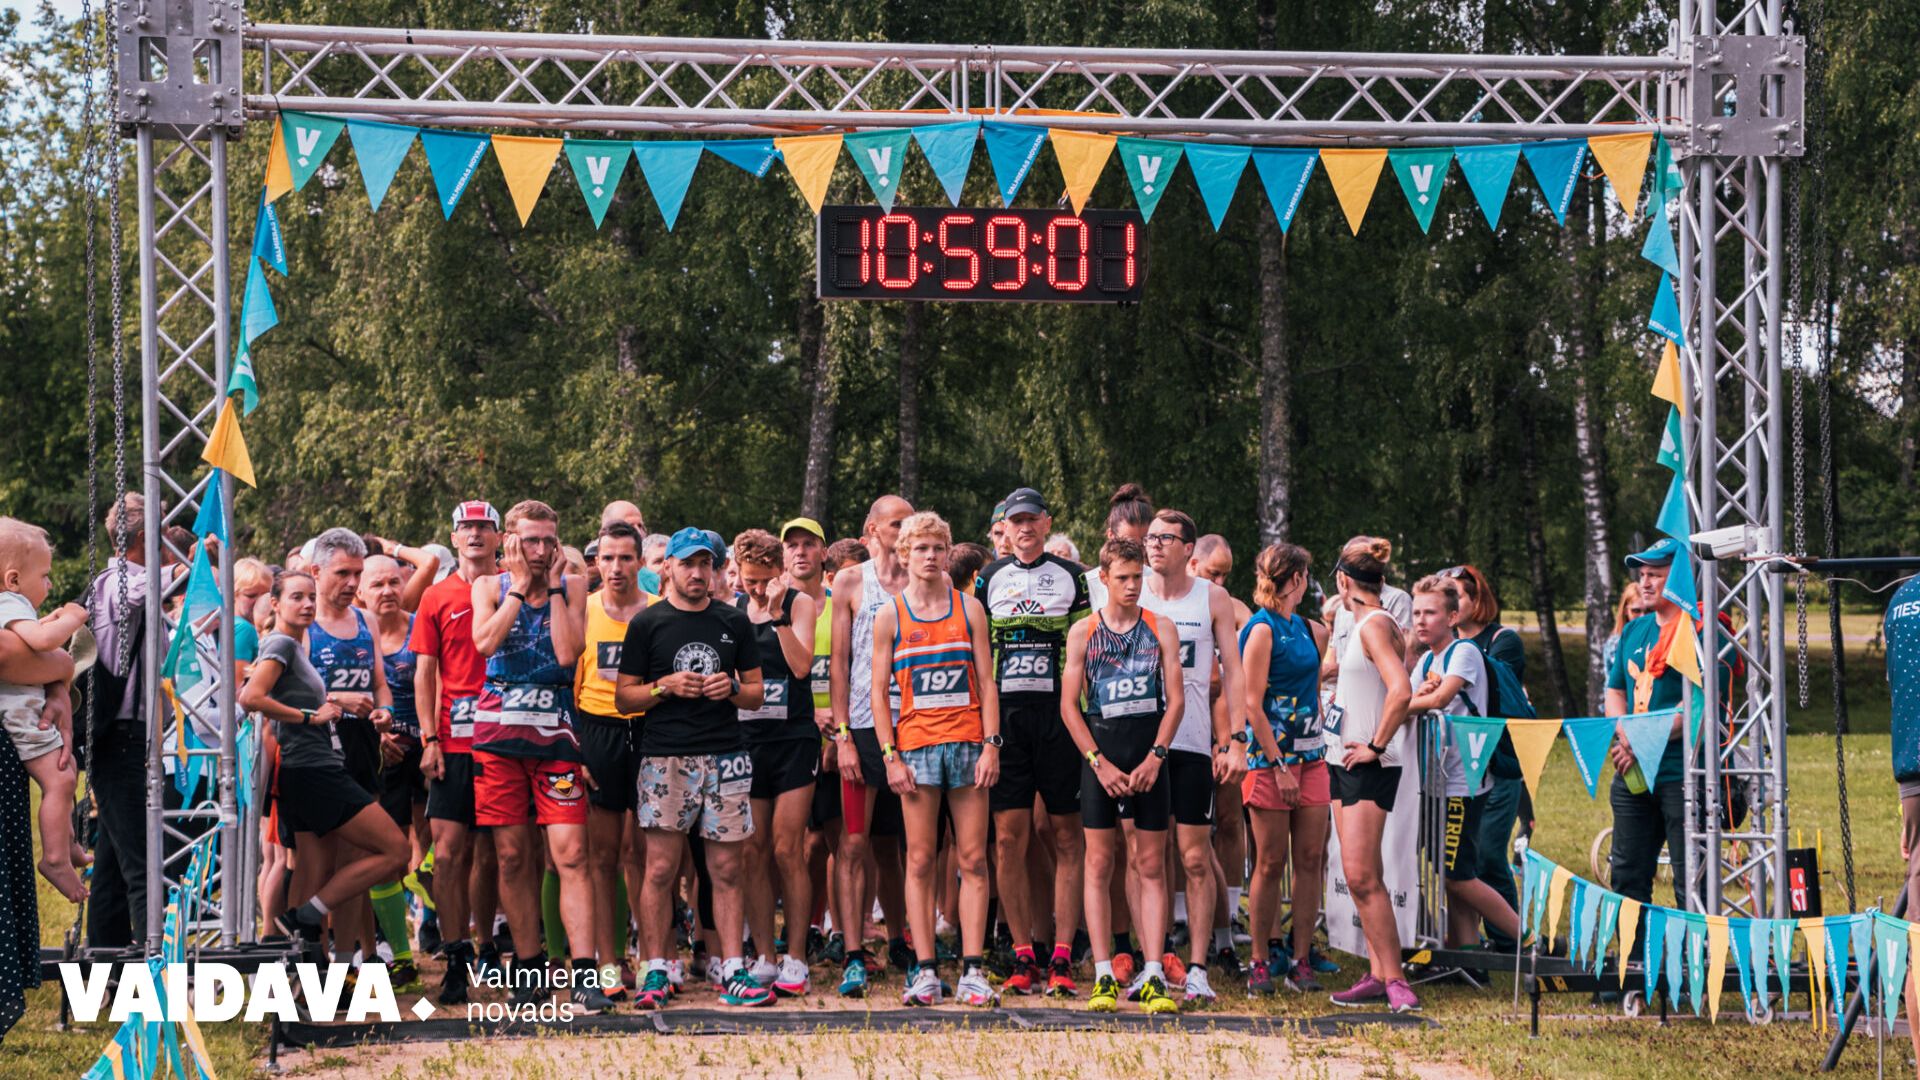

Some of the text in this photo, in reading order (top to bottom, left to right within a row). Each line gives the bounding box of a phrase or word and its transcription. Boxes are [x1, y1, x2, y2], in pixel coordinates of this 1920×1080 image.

[861, 215, 1135, 291] 10:59:01
[811, 658, 830, 677] 4
[1005, 655, 1049, 676] 256
[330, 668, 371, 689] 279
[920, 669, 963, 693] 197
[1106, 675, 1149, 701] 193
[504, 688, 554, 709] 248
[720, 755, 752, 779] 205
